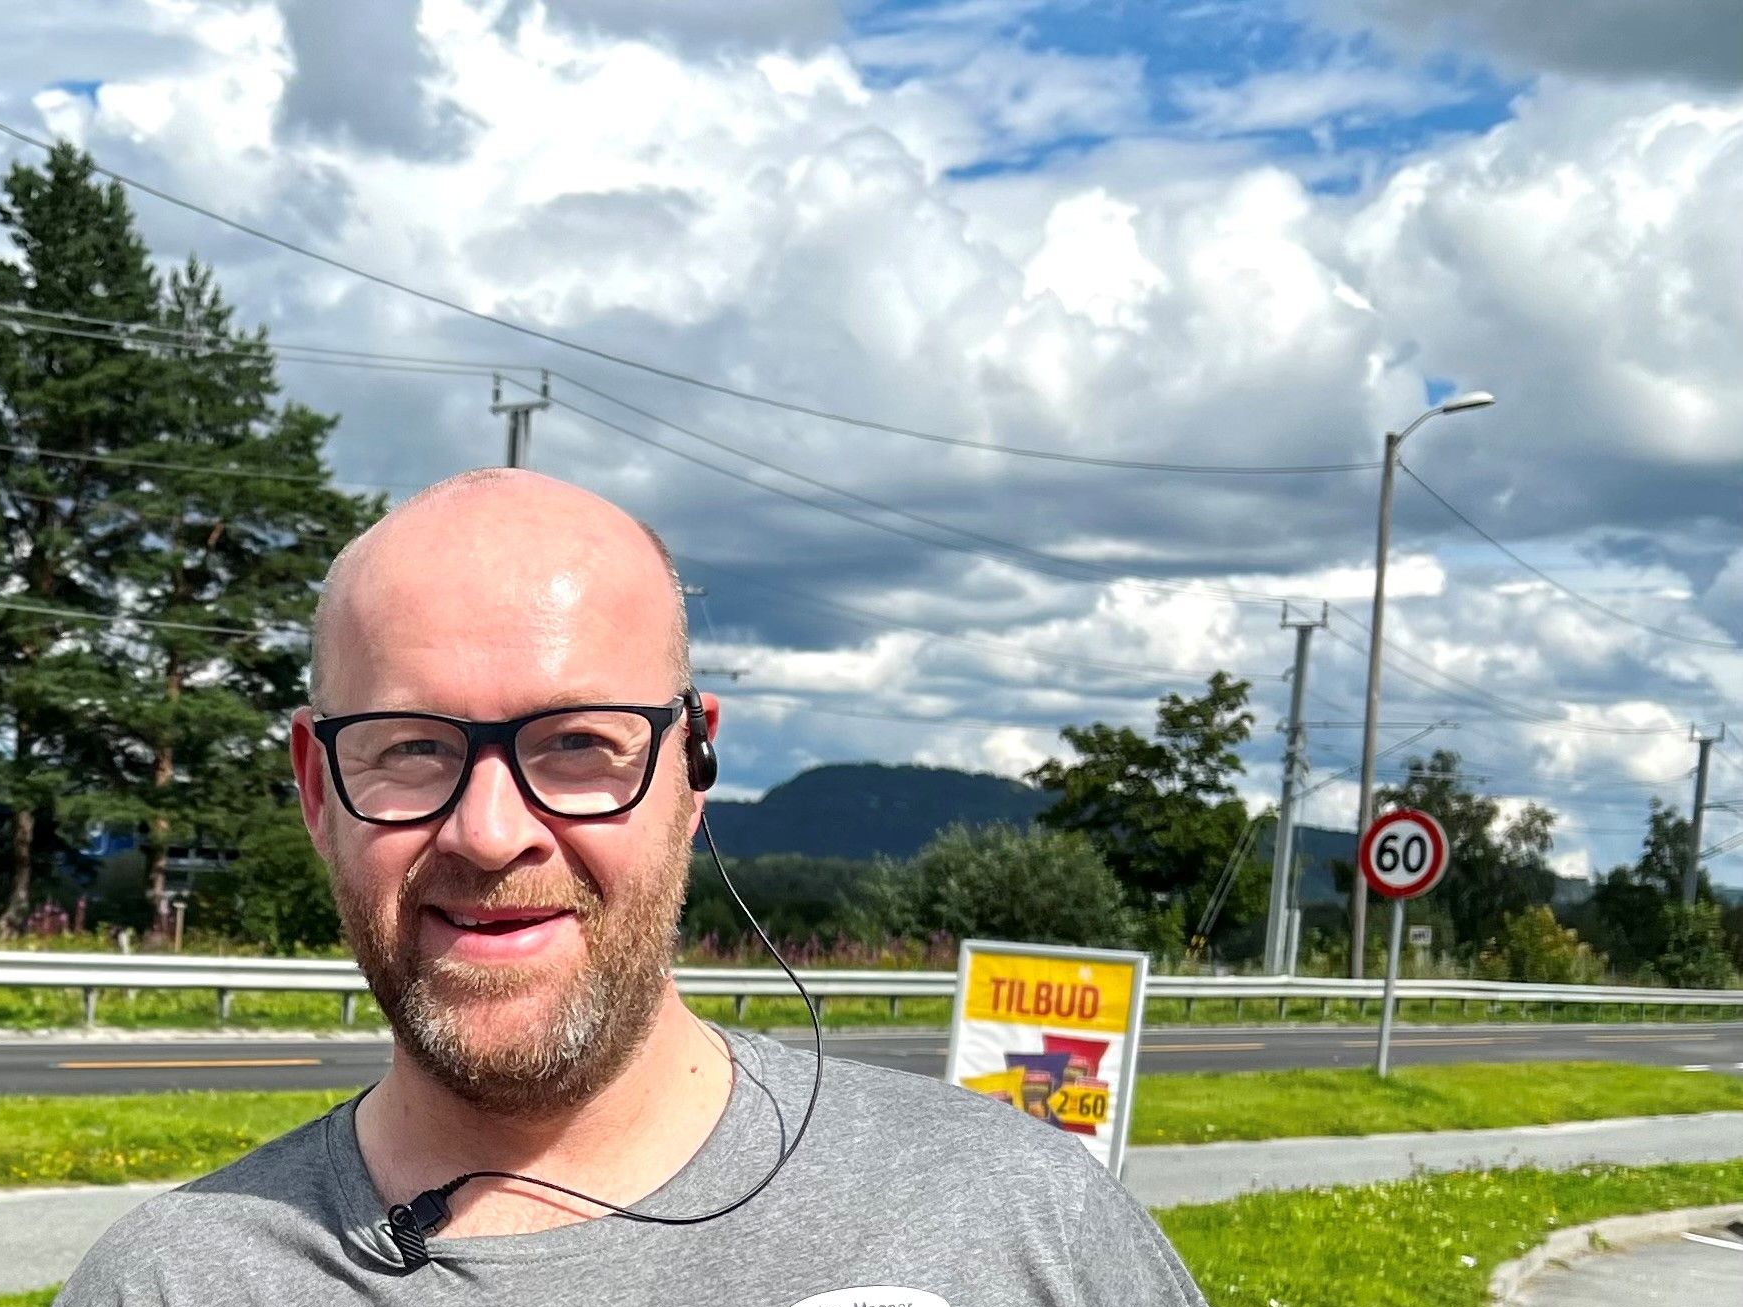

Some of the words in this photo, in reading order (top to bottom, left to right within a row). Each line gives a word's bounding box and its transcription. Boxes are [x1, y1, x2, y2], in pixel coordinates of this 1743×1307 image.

[1376, 834, 1427, 873] 60
[991, 977, 1099, 1020] TILBUD
[1057, 1091, 1069, 1115] 2
[1078, 1094, 1106, 1119] 60
